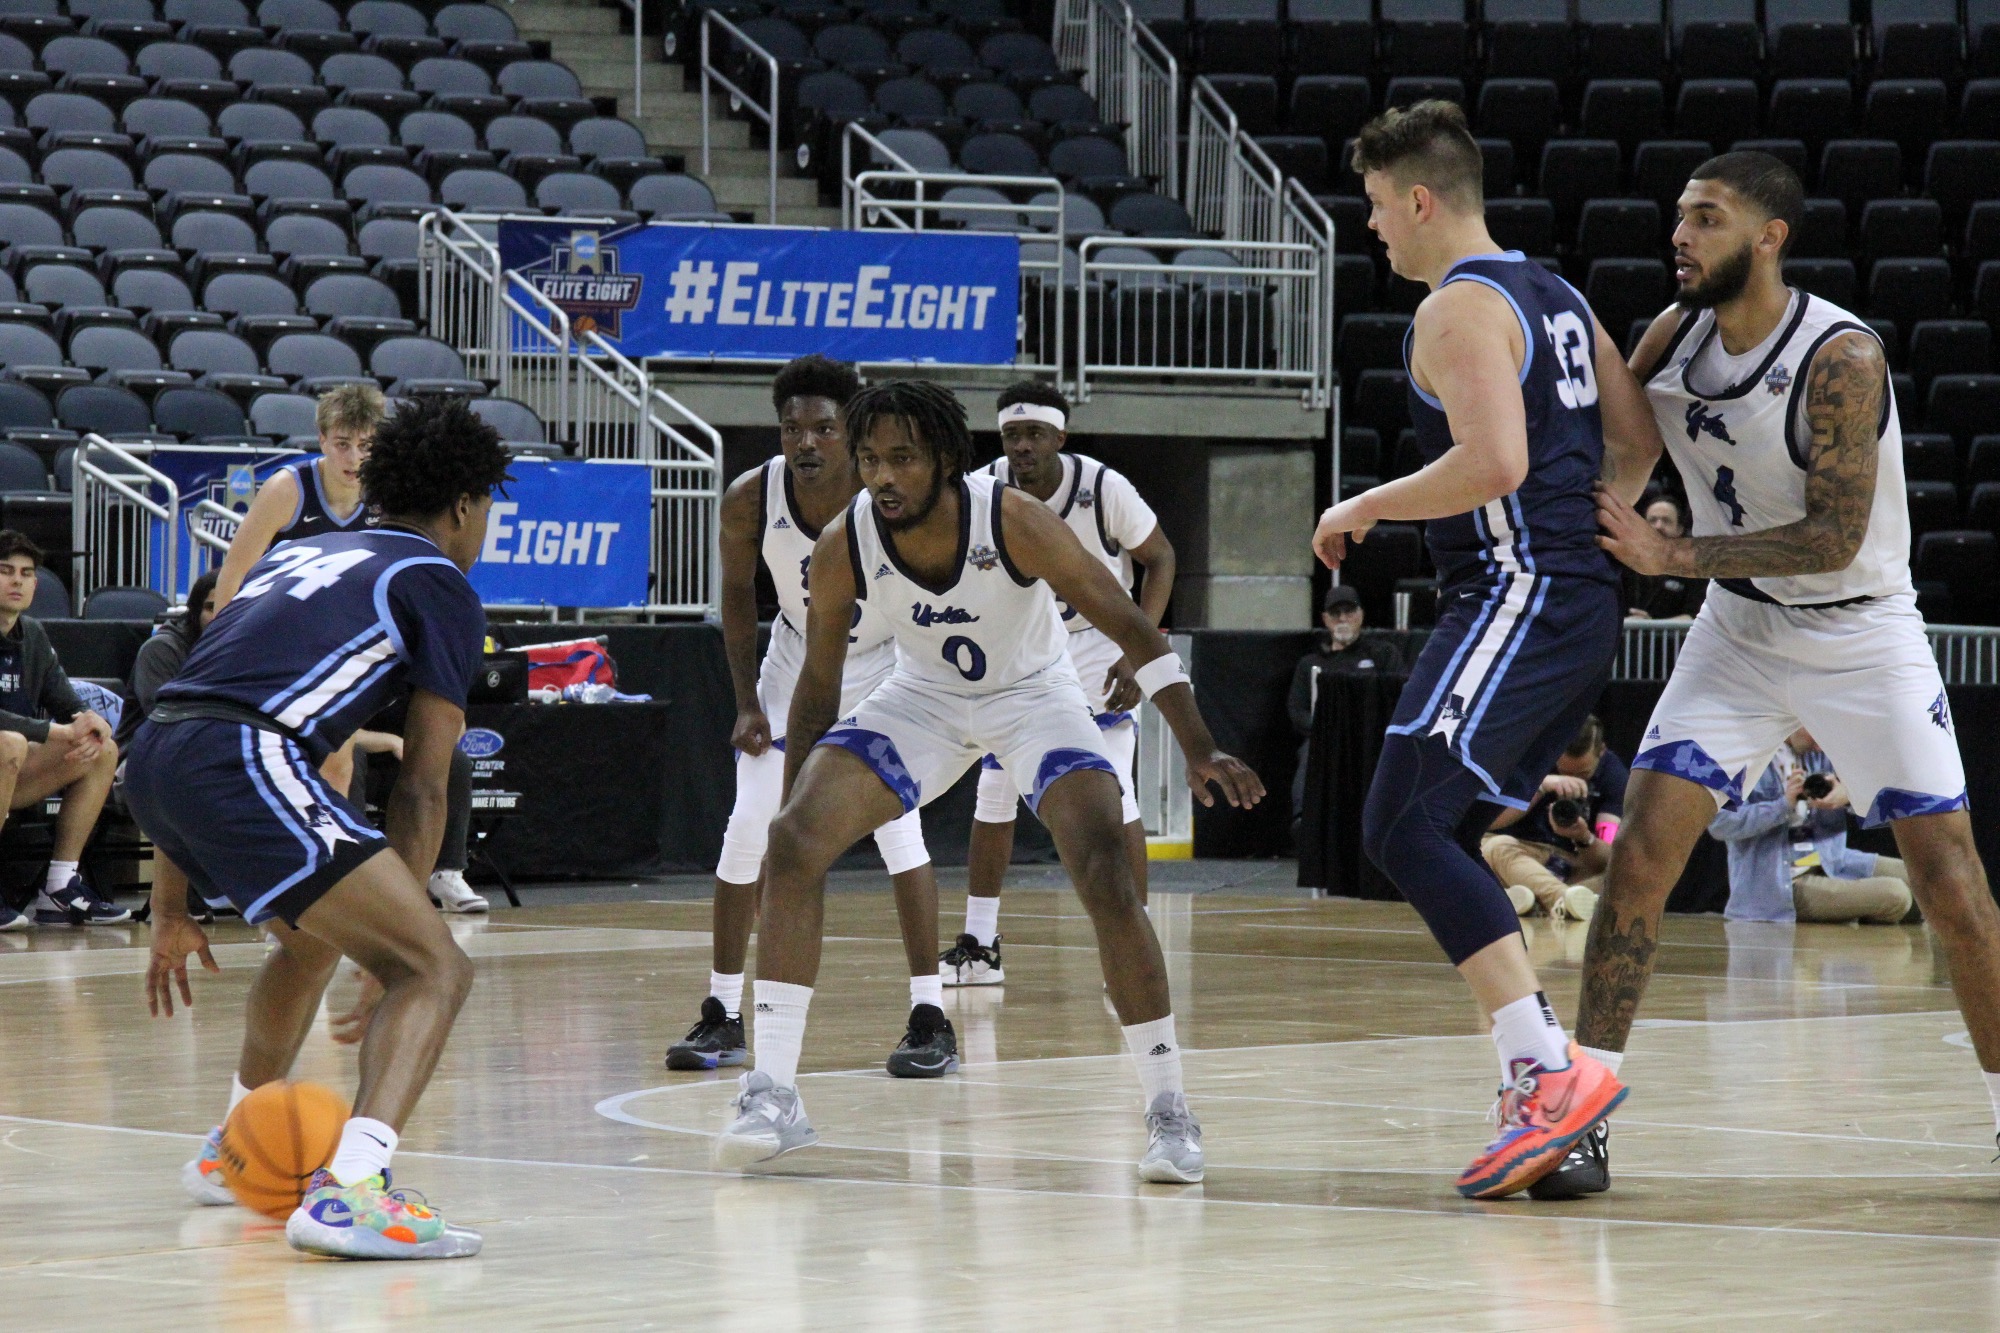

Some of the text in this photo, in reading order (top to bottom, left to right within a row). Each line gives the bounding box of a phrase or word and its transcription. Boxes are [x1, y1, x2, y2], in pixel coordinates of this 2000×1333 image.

[541, 281, 632, 301] ELITE EIGHT
[476, 501, 620, 566] EIGHT
[231, 545, 378, 602] 24
[942, 635, 986, 682] 0
[461, 733, 494, 752] Ford
[475, 760, 505, 770] CENTER
[46, 803, 61, 814] MAK
[472, 797, 517, 808] MAKE IT YOURS
